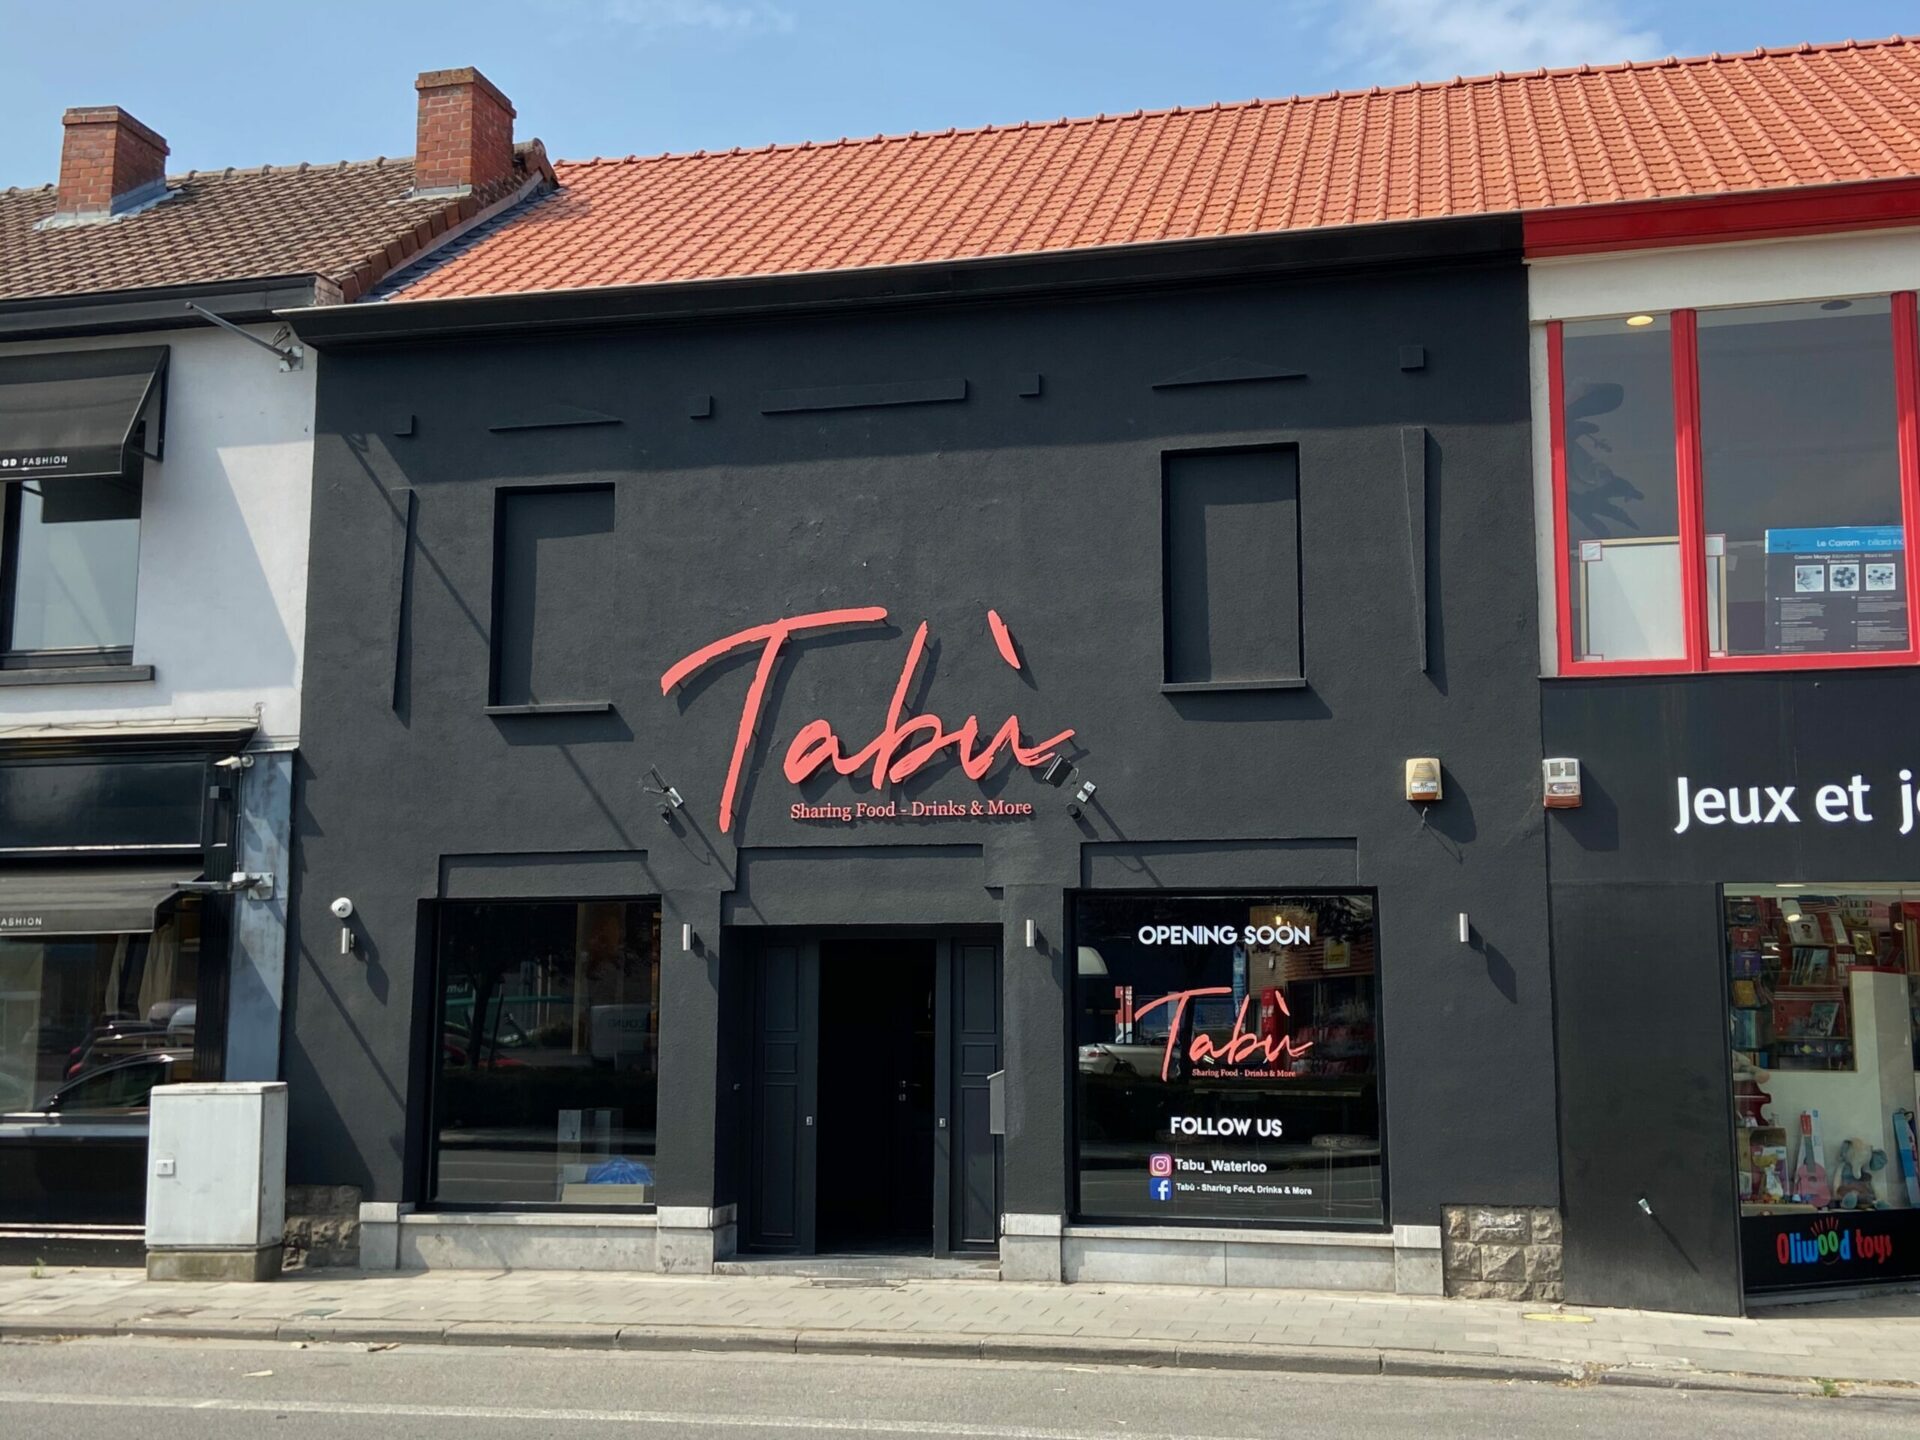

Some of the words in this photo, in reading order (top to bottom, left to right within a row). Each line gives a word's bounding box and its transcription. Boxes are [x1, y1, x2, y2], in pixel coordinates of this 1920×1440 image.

[0, 459, 17, 467] OD
[22, 455, 68, 465] FASHION
[661, 607, 1075, 833] Tabù
[790, 803, 852, 821] Sharing
[856, 802, 896, 817] Food
[911, 800, 966, 816] Drinks
[970, 800, 984, 816] &
[987, 800, 1032, 815] More
[1674, 776, 1801, 834] Jeux
[1814, 774, 1874, 822] et
[1899, 769, 1920, 835] j
[1138, 925, 1238, 945] OPENING
[1244, 925, 1311, 945] SOON
[1134, 986, 1313, 1082] Tabù
[1192, 1068, 1220, 1078] Sharing
[1221, 1069, 1238, 1077] Food
[1244, 1069, 1268, 1077] Drinks
[1170, 1117, 1252, 1136] FOLLOW
[1257, 1118, 1283, 1137] US
[1174, 1158, 1267, 1173] Tabu_Waterloo
[1201, 1184, 1232, 1194] Sharing
[1233, 1185, 1256, 1194] Food,
[1257, 1186, 1282, 1194] Drinks
[1292, 1187, 1312, 1195] More
[1776, 1229, 1851, 1264] Oliwood
[1856, 1228, 1892, 1264] toys
